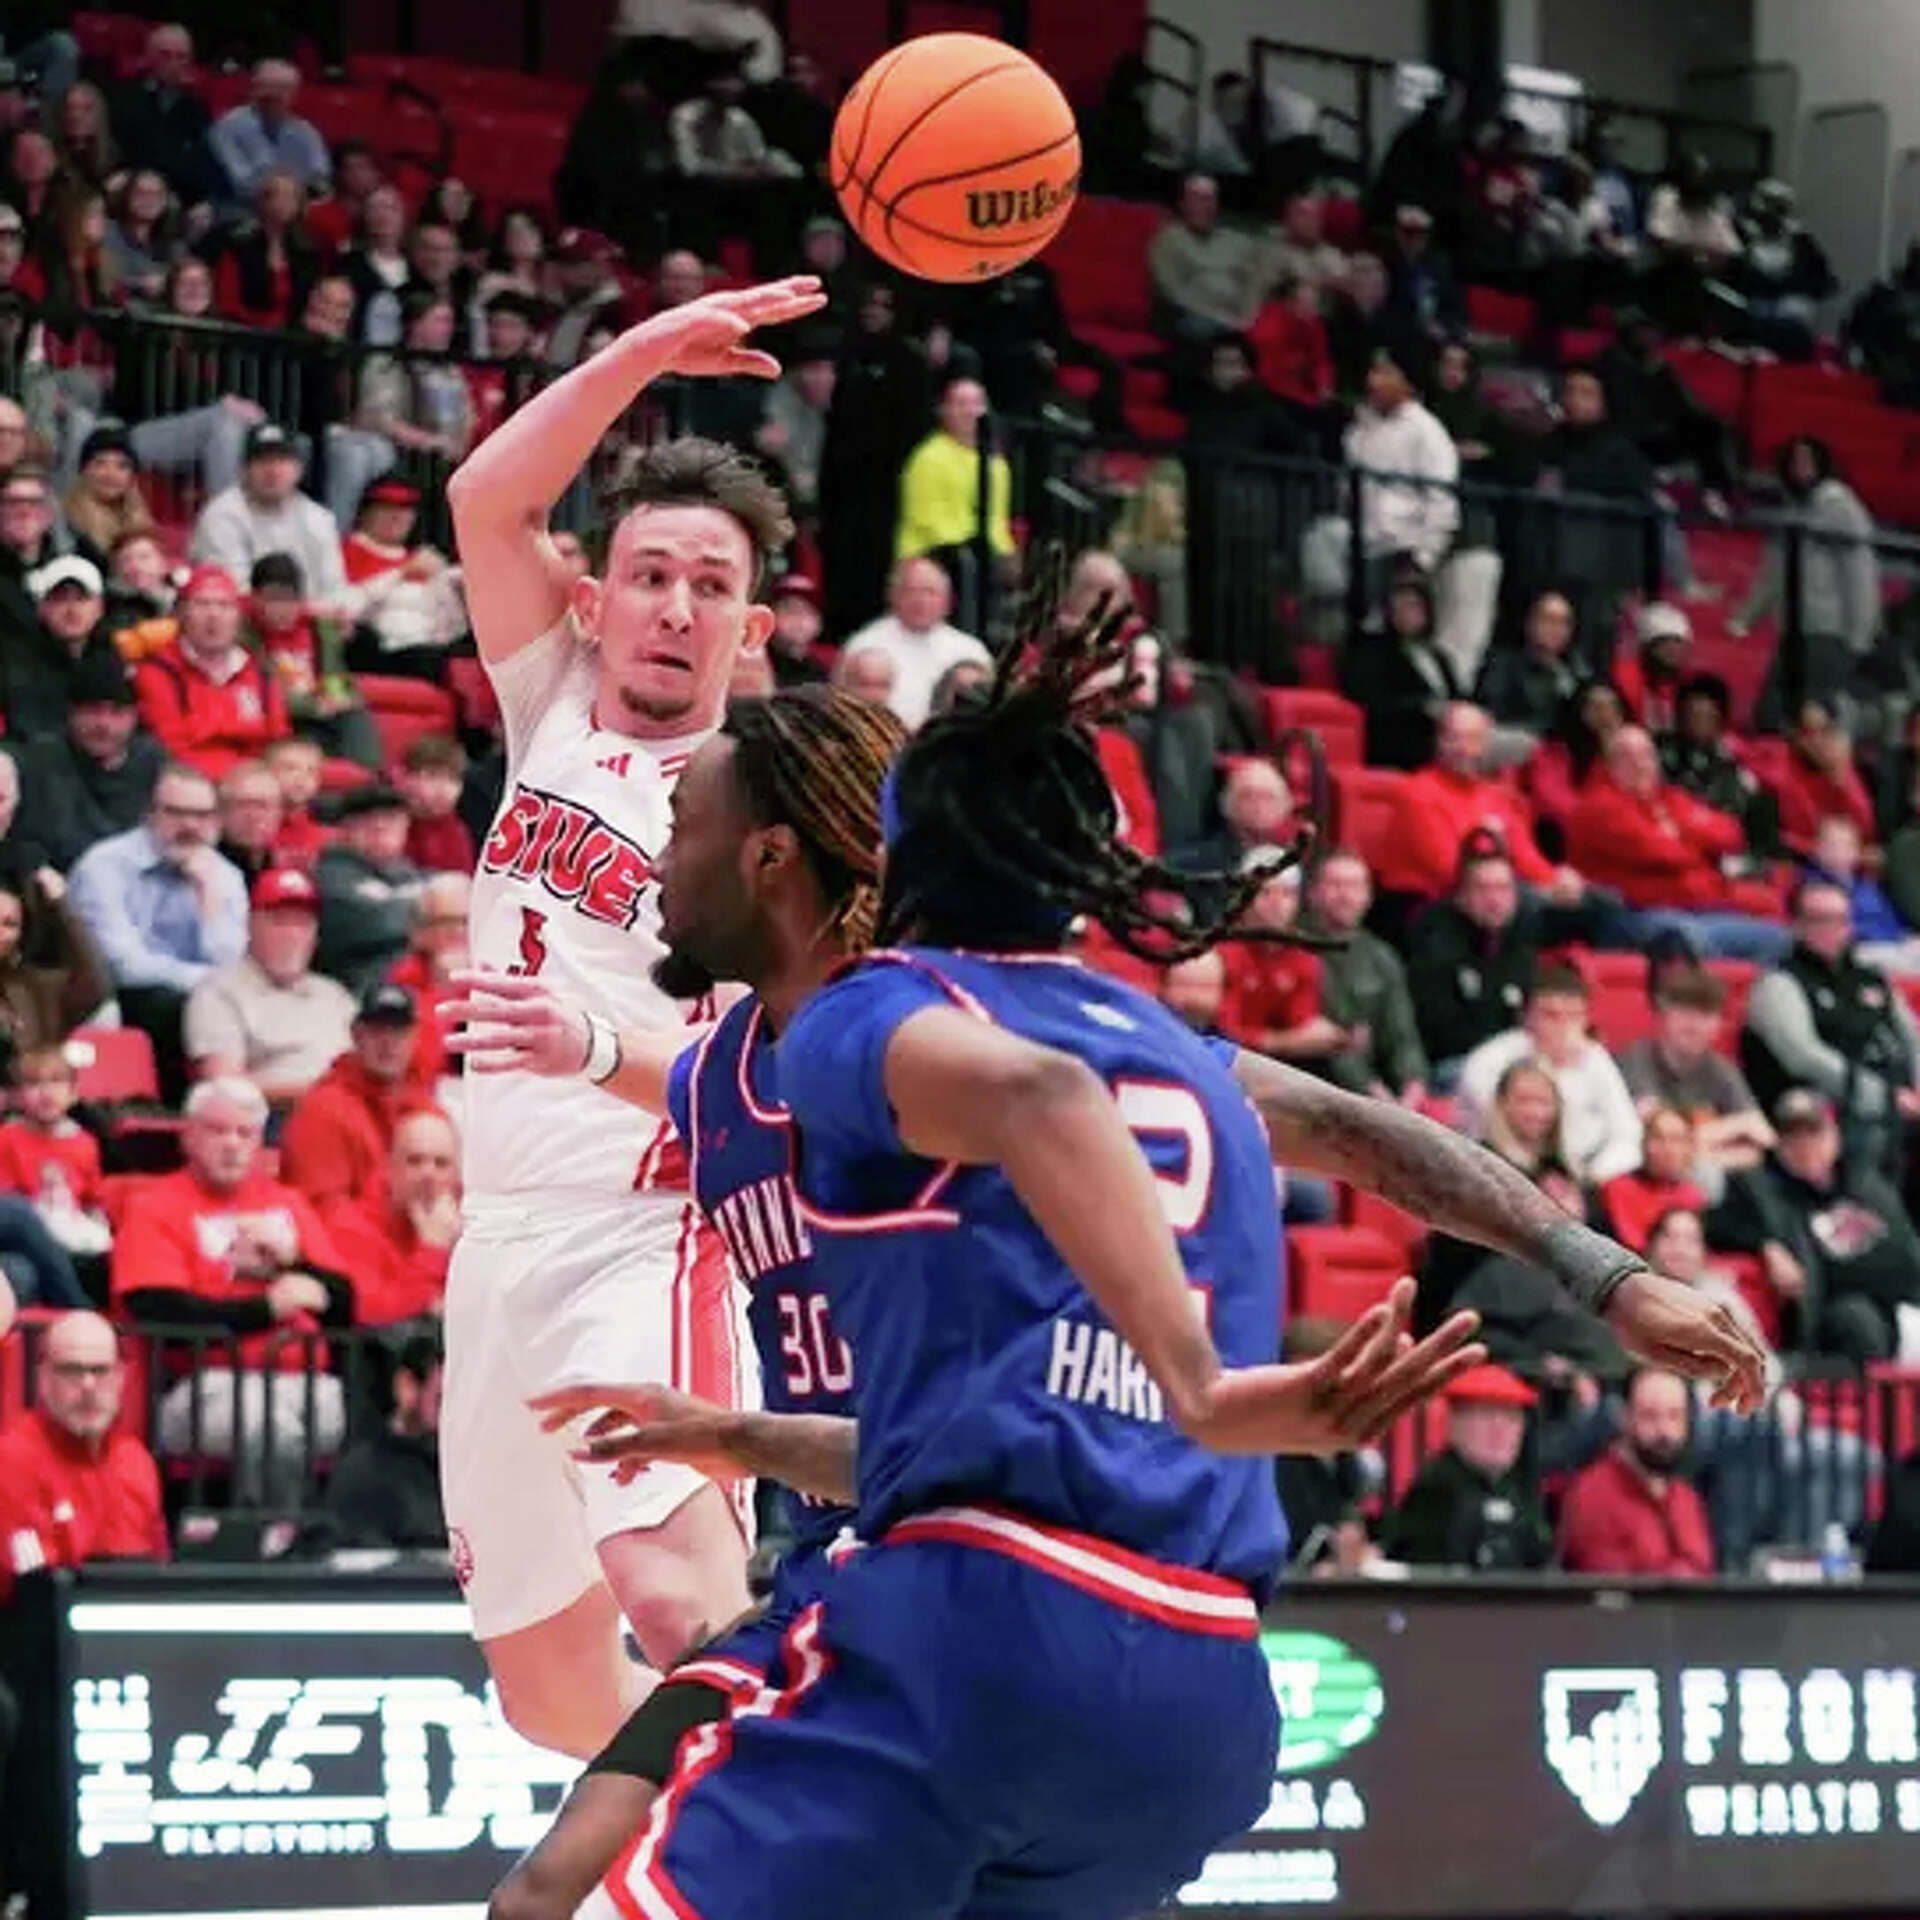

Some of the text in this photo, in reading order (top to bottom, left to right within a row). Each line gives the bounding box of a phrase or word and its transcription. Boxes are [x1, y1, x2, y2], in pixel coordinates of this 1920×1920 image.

[484, 782, 652, 931] SIUE
[776, 1293, 854, 1395] 30
[1047, 1318, 1163, 1422] HAR
[73, 1675, 154, 1857] THE
[1686, 1780, 1881, 1837] WEALTH
